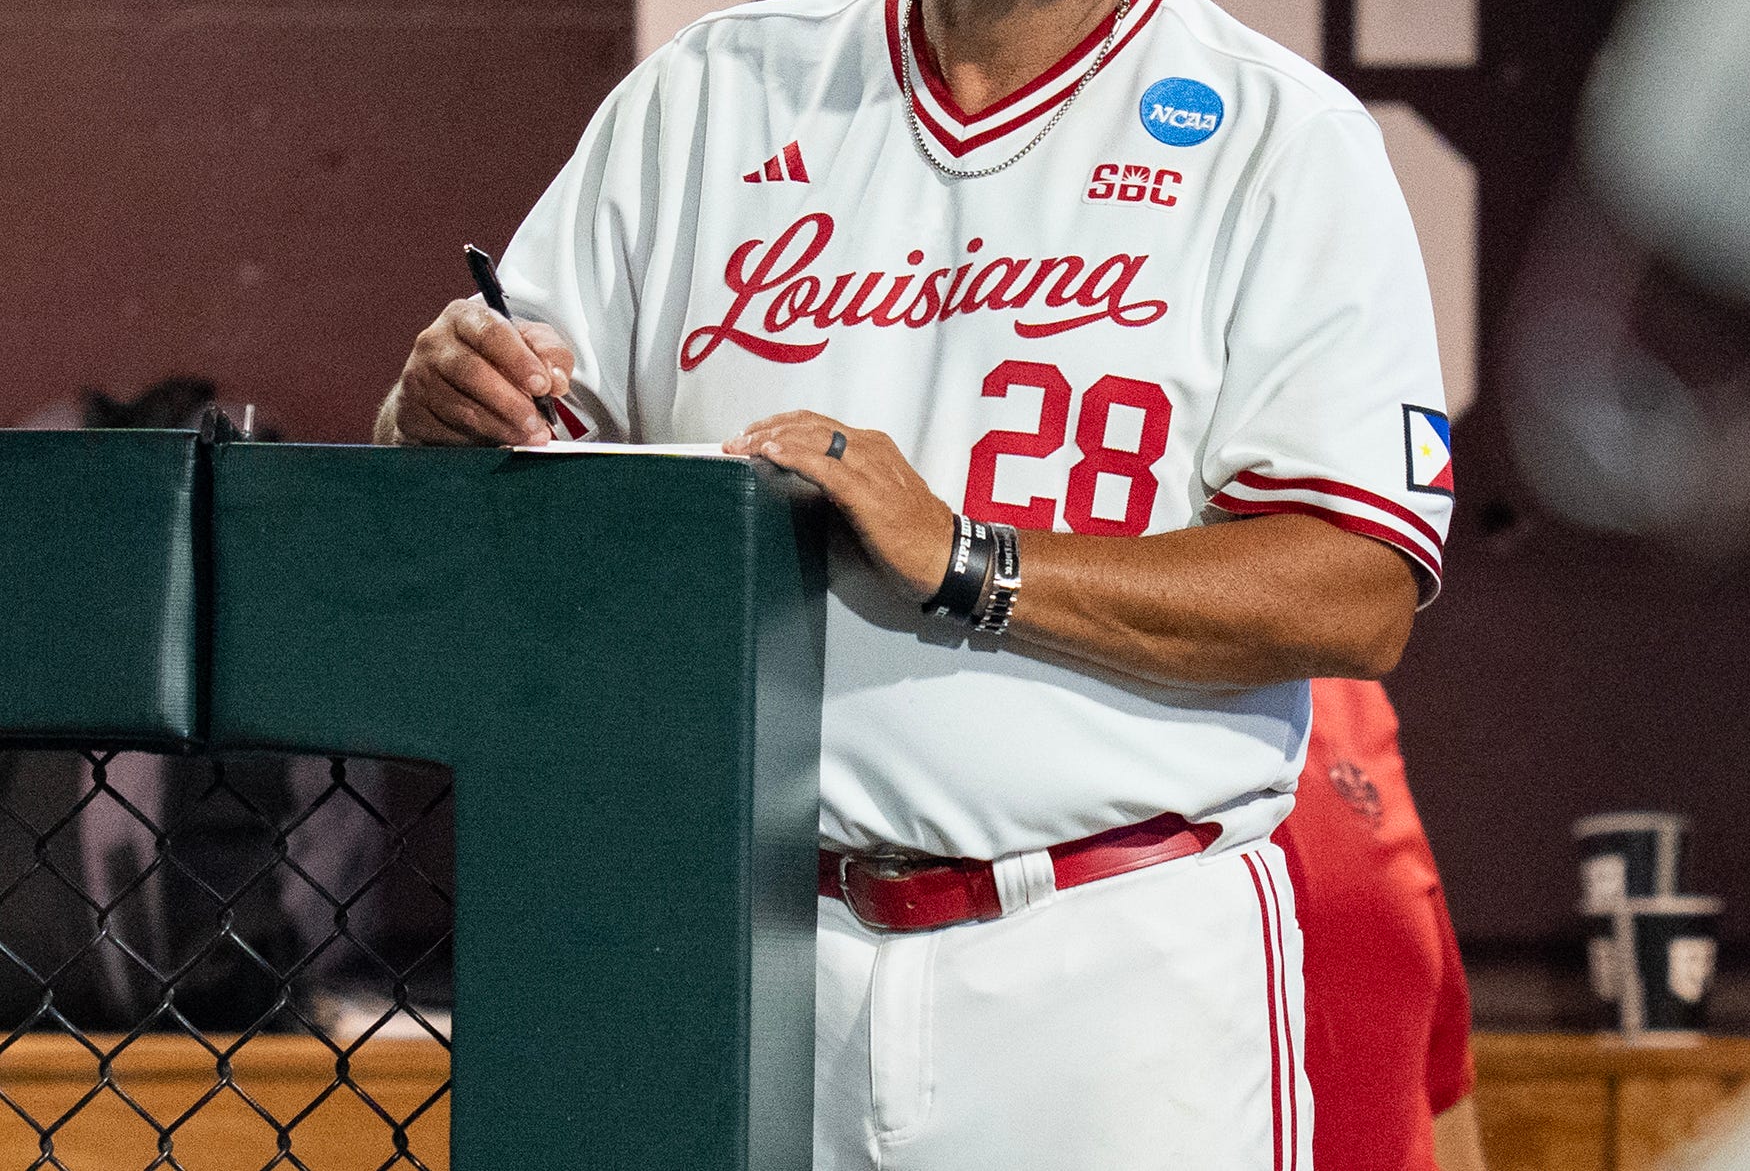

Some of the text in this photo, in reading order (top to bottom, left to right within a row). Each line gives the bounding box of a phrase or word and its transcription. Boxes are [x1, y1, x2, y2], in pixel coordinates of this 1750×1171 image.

[1150, 103, 1217, 131] NCAA
[1087, 163, 1183, 207] SBC
[679, 210, 1168, 373] Louisiana
[961, 359, 1173, 536] 28
